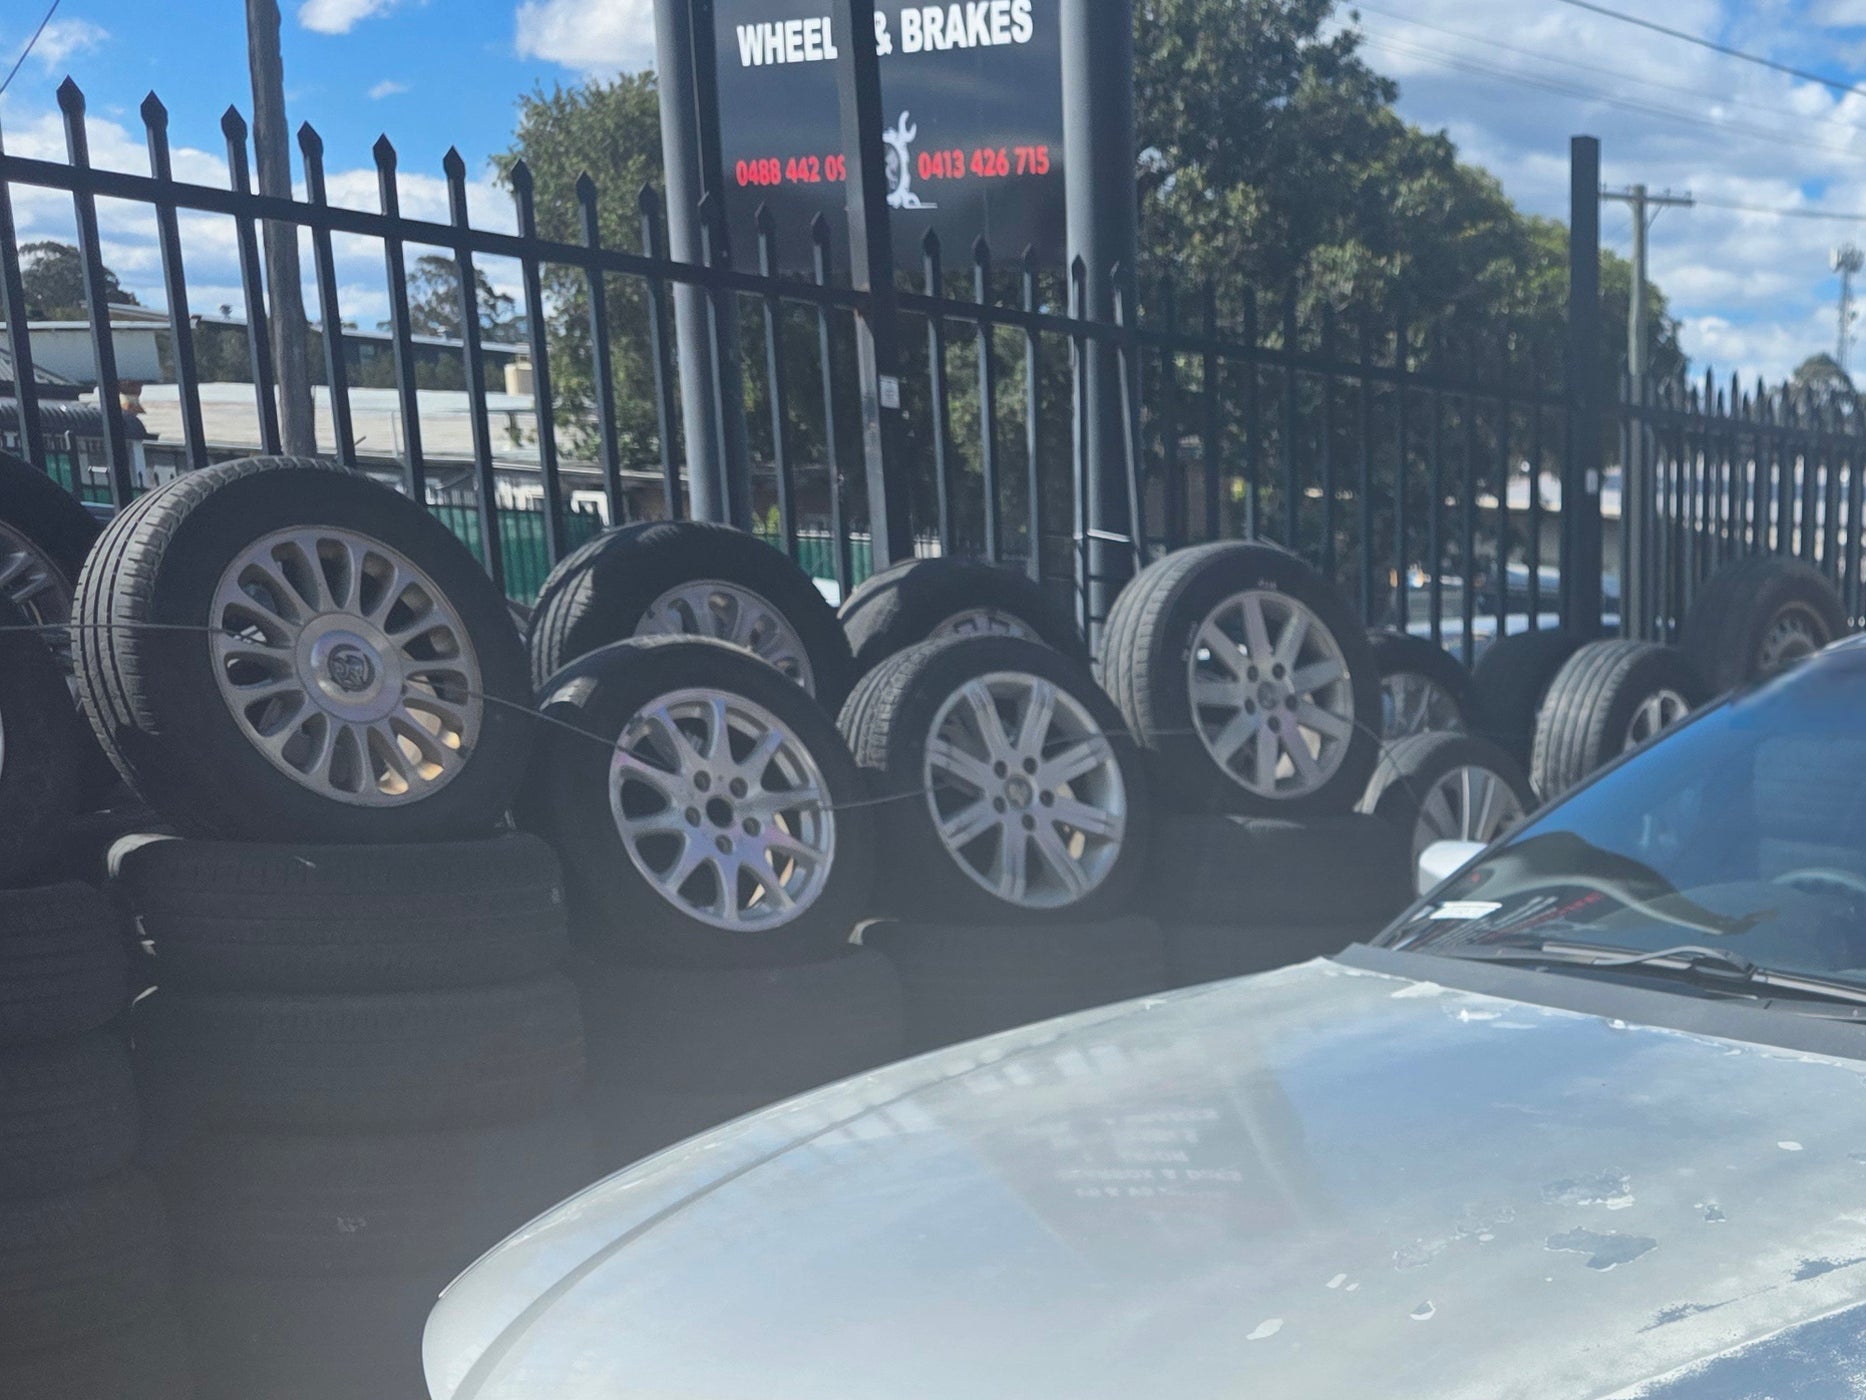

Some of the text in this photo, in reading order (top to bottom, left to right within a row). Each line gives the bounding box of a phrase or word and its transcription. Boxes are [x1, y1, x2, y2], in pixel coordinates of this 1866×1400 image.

[736, 16, 838, 67] WHEEL
[900, 0, 1034, 53] BRAKES
[735, 158, 782, 187] 0488
[785, 154, 821, 184] 442
[917, 144, 1050, 181] 0413 426 715
